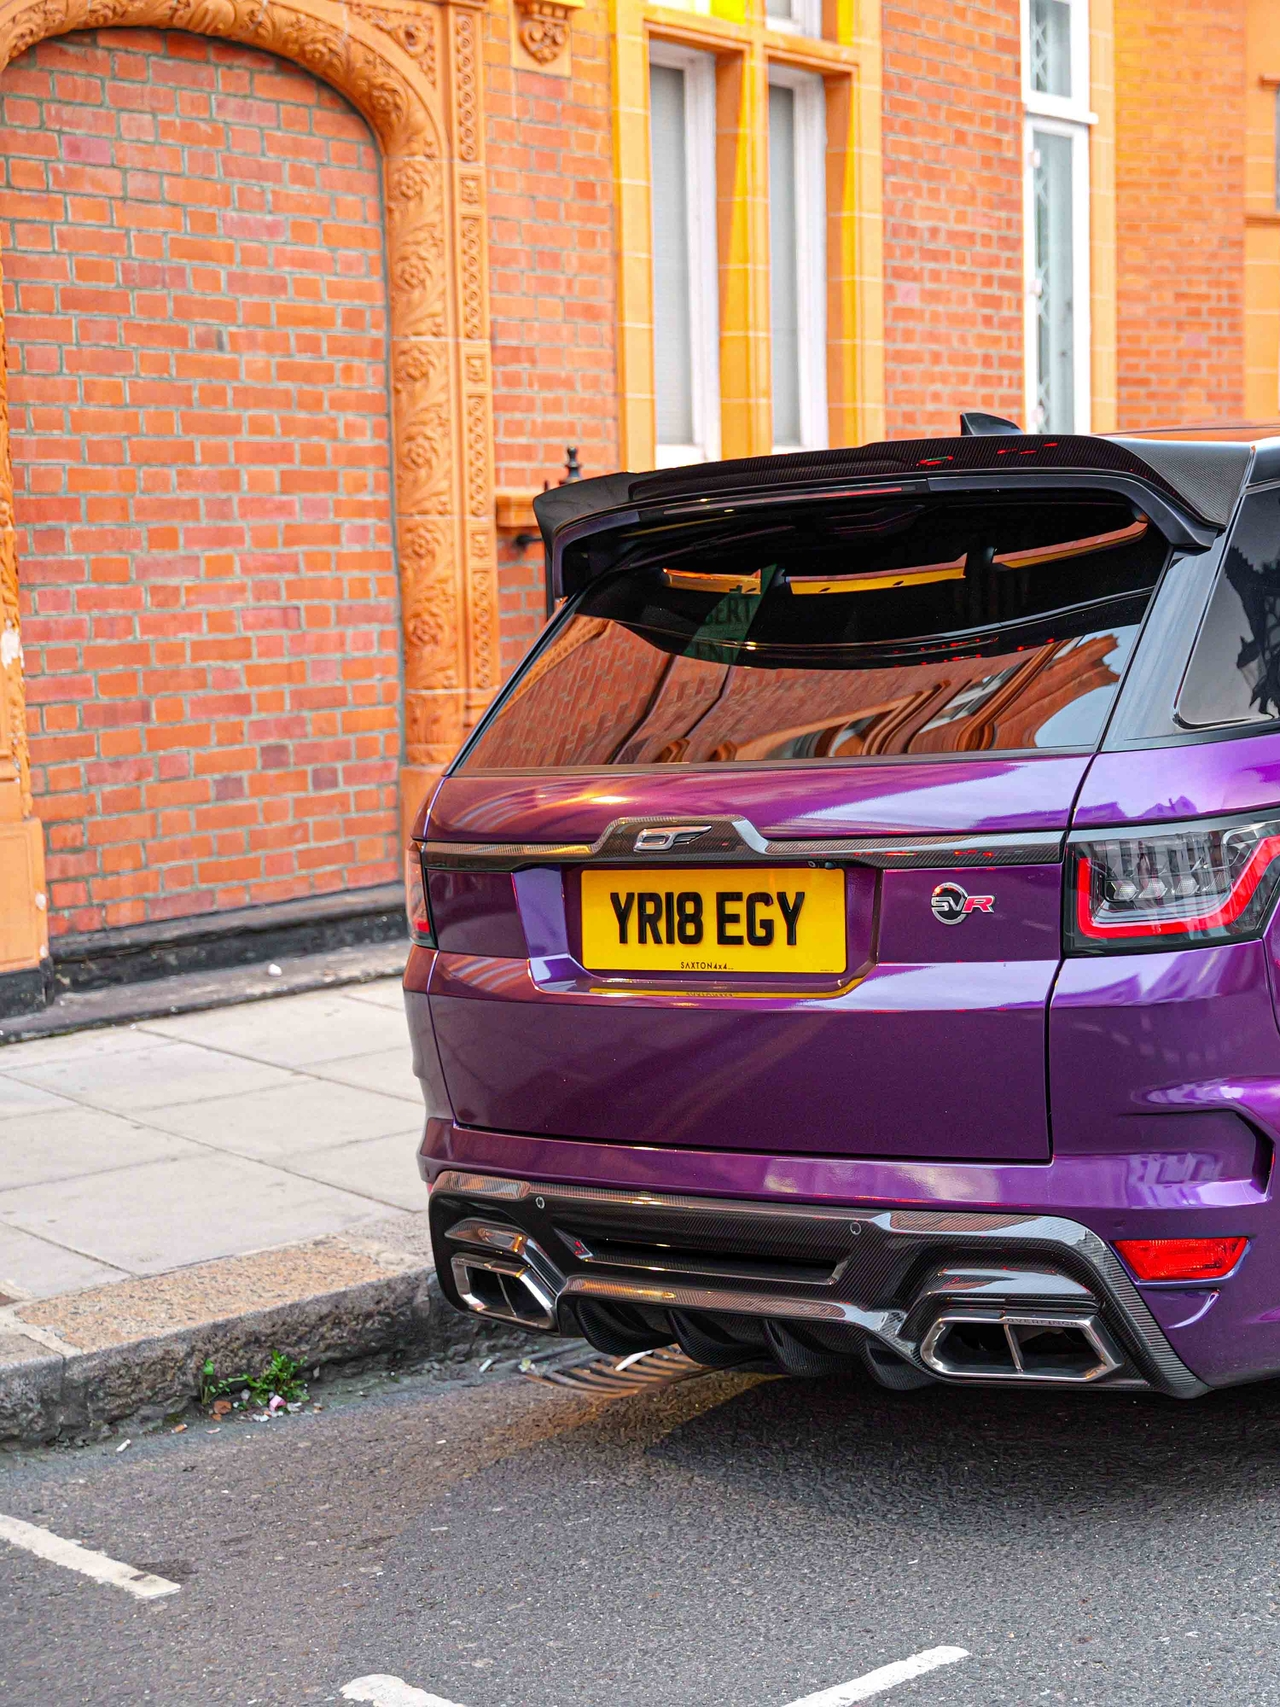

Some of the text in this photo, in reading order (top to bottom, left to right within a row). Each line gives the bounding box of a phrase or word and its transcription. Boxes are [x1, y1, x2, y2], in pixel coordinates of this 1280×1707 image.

[610, 891, 805, 946] YR18 EGY
[1006, 1317, 1077, 1327] OVERFINCH
